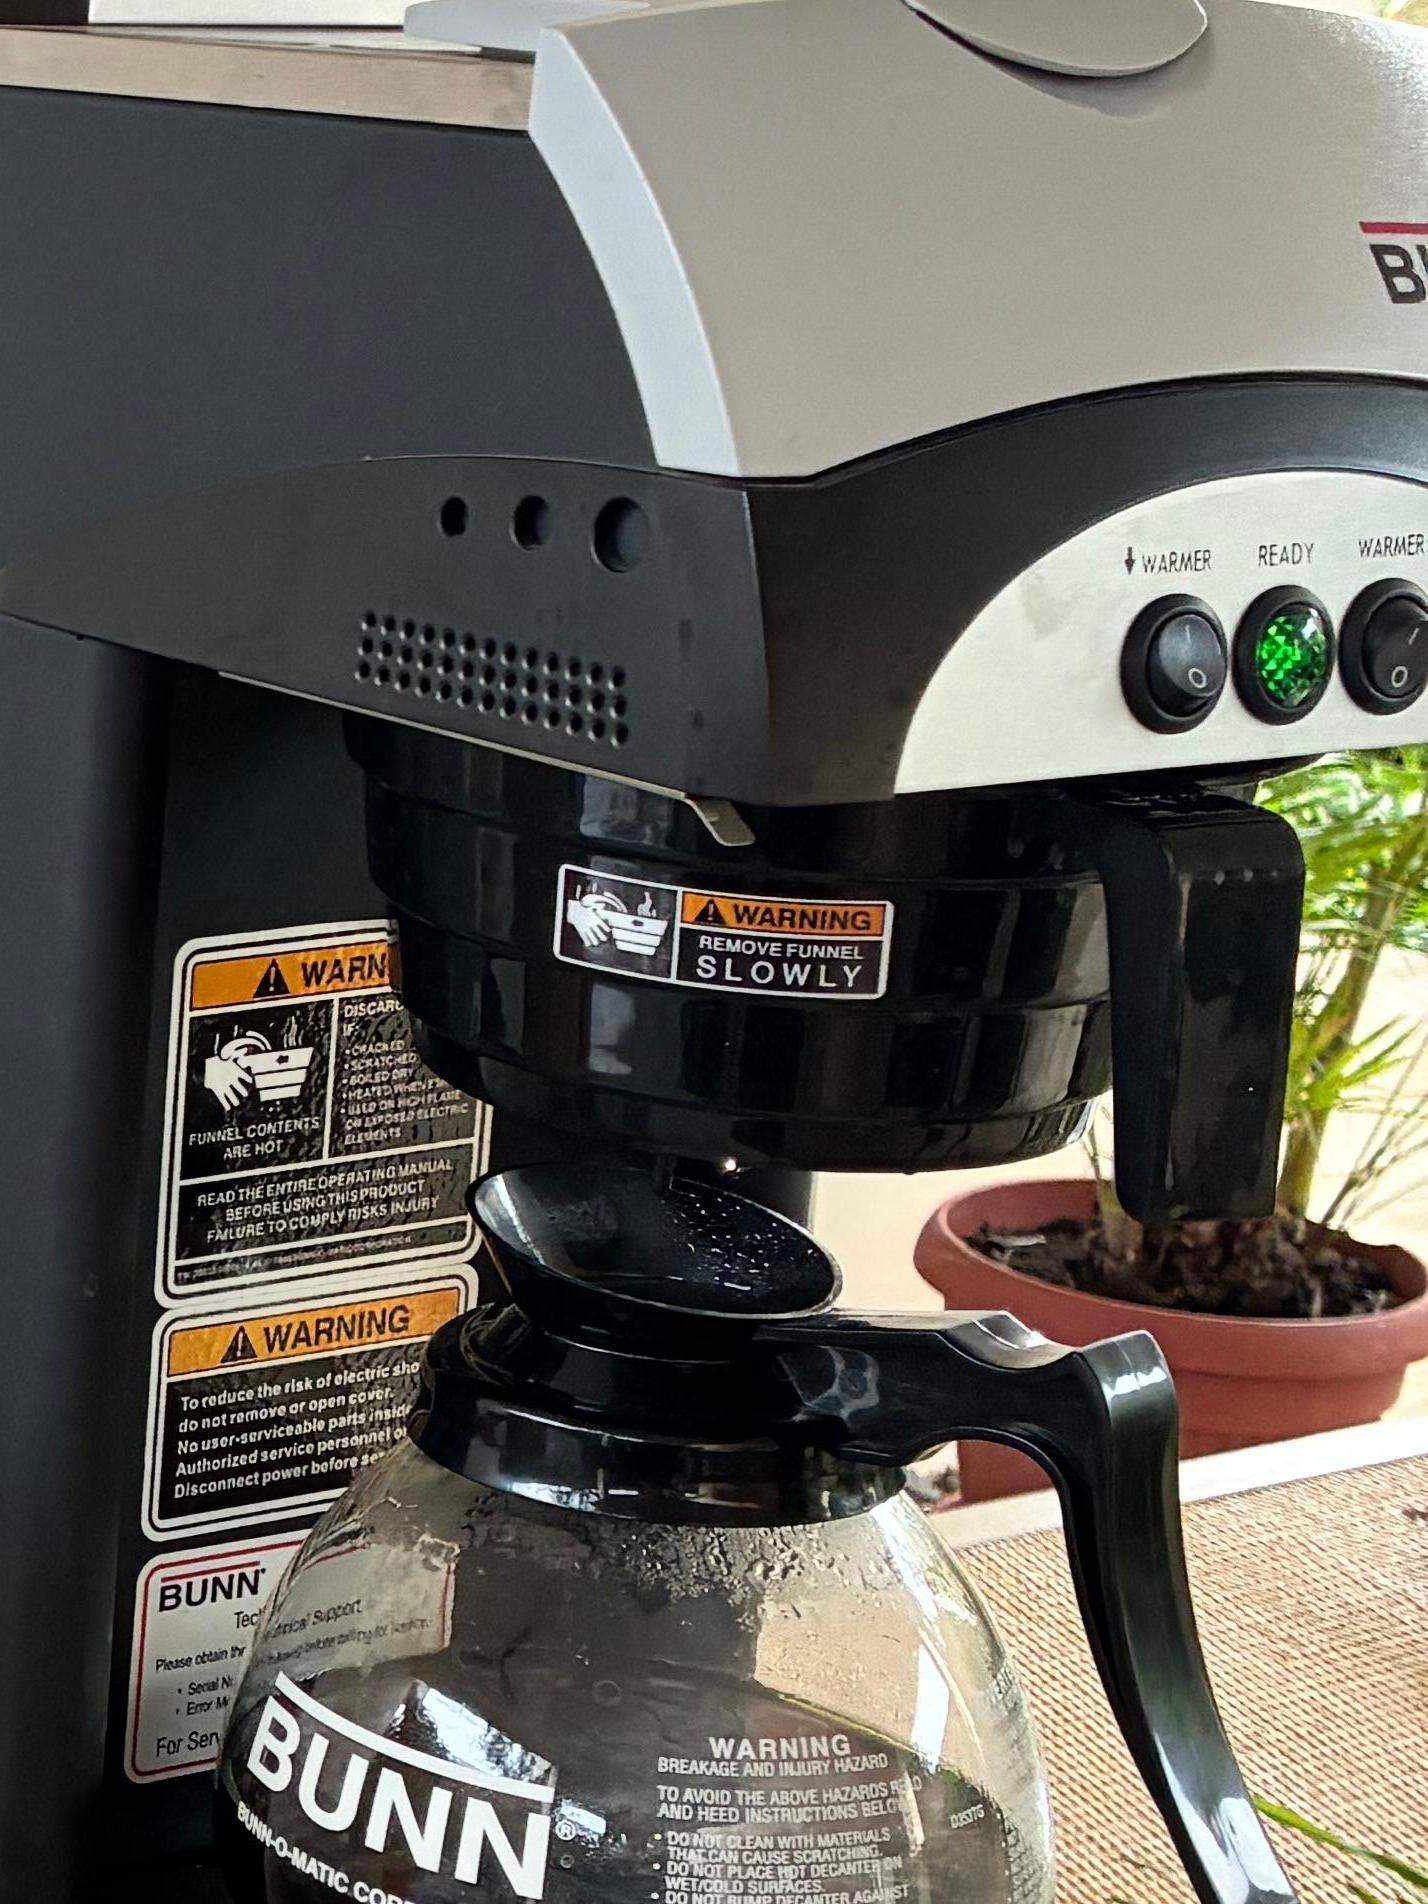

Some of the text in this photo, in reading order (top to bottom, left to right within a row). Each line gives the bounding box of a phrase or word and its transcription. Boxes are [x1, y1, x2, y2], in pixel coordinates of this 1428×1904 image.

[1369, 243, 1428, 305] B
[1142, 549, 1212, 576] WARMER
[1257, 542, 1315, 569] READY
[1358, 533, 1426, 559] WARMER
[733, 903, 871, 931] WARNING
[699, 935, 863, 960] REMOVE FUNNEL
[300, 951, 387, 989] WARN
[696, 955, 862, 988] SLOWLY
[188, 1115, 321, 1147] FUNNEL CONTENTS
[223, 1139, 284, 1160] ARE HOT
[197, 1157, 454, 1208] READ THE ENTIRE OPERATING MANUAL
[225, 1179, 426, 1223] BEFORE USING THIS PRODUCT
[206, 1194, 440, 1245] FAILURE TO COMPLY RISKS INJURY
[263, 1304, 410, 1354] WARNING
[181, 1361, 420, 1413] To reduce the risk of electric sho
[177, 1404, 412, 1455] No user-serviceable parts insid
[178, 1387, 394, 1434] do not remove or open cover.
[175, 1431, 391, 1477] Authorized service personnel
[174, 1456, 358, 1499] Disconnect power before
[159, 1570, 255, 1613] BUNN
[155, 1655, 193, 1673] Please
[657, 1752, 888, 1777] BREAKAGE AND INJURY HAZARD
[708, 1733, 851, 1761] WARNING
[246, 1695, 551, 1900] BUNN
[656, 1782, 888, 1806] TO AVOID THE ABOVE HAZARDS
[656, 1801, 859, 1825] AND HEED INSTRUCTIONS
[237, 1799, 350, 1894] BUNN-O-MATIC
